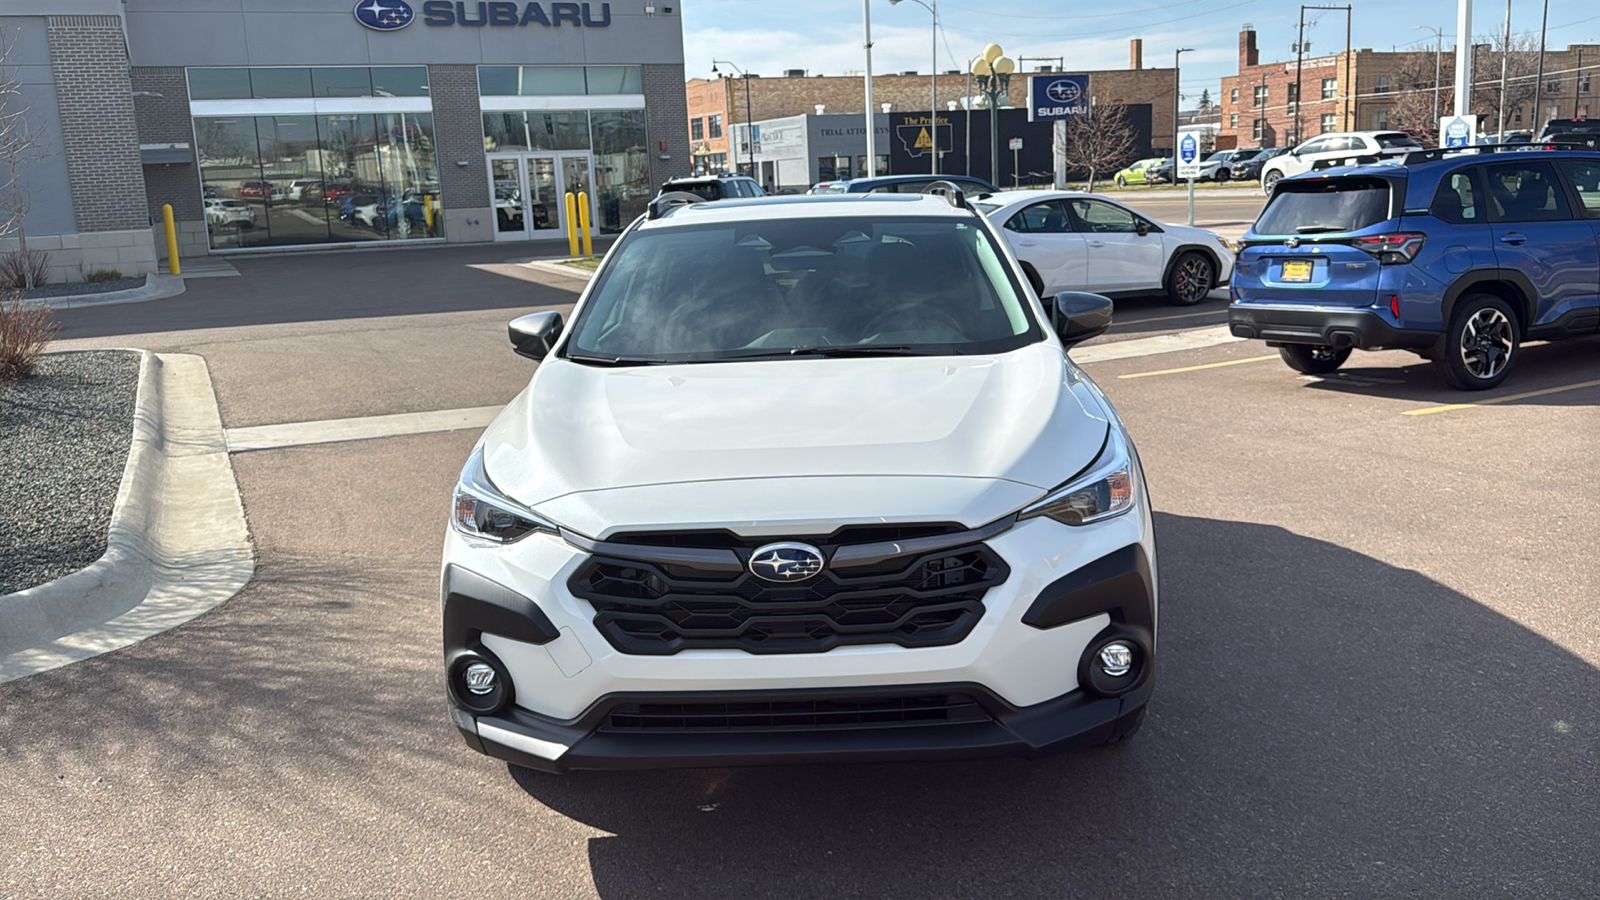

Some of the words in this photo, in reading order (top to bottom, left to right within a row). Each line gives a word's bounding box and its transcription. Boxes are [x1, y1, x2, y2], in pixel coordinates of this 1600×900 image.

[423, 0, 611, 27] SUBARU
[1038, 106, 1086, 116] SUBARU
[903, 117, 918, 125] The
[919, 116, 949, 125] Pratice
[820, 128, 844, 137] TRIAL
[845, 127, 890, 136] ATTOEYS
